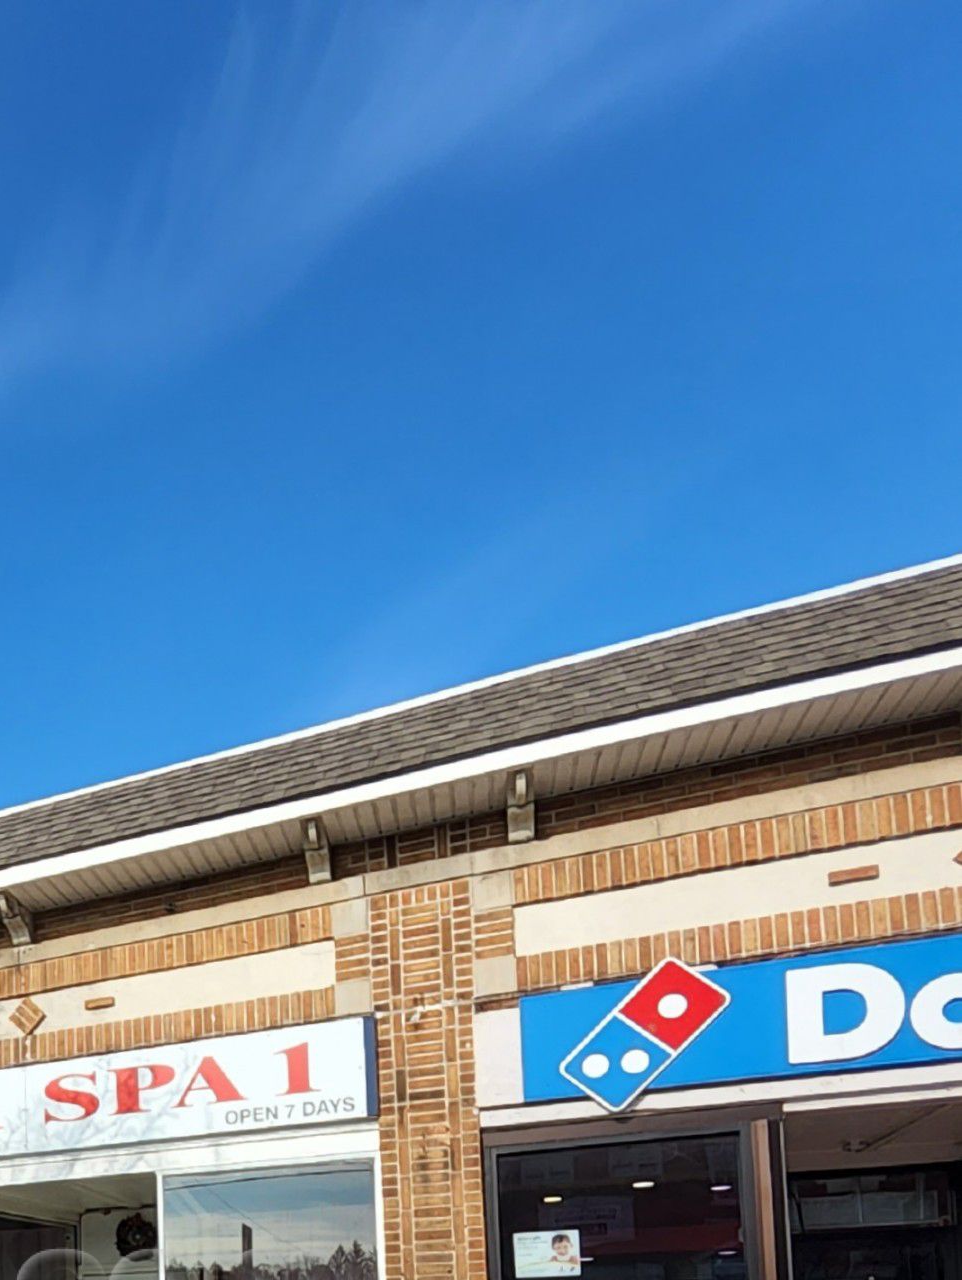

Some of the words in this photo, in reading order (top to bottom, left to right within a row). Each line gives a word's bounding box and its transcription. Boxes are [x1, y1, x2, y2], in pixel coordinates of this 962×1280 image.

[44, 1056, 248, 1124] SPA
[274, 1042, 322, 1096] 1
[224, 1105, 279, 1125] OPEN
[284, 1104, 295, 1119] 7
[302, 1096, 356, 1117] DAYS
